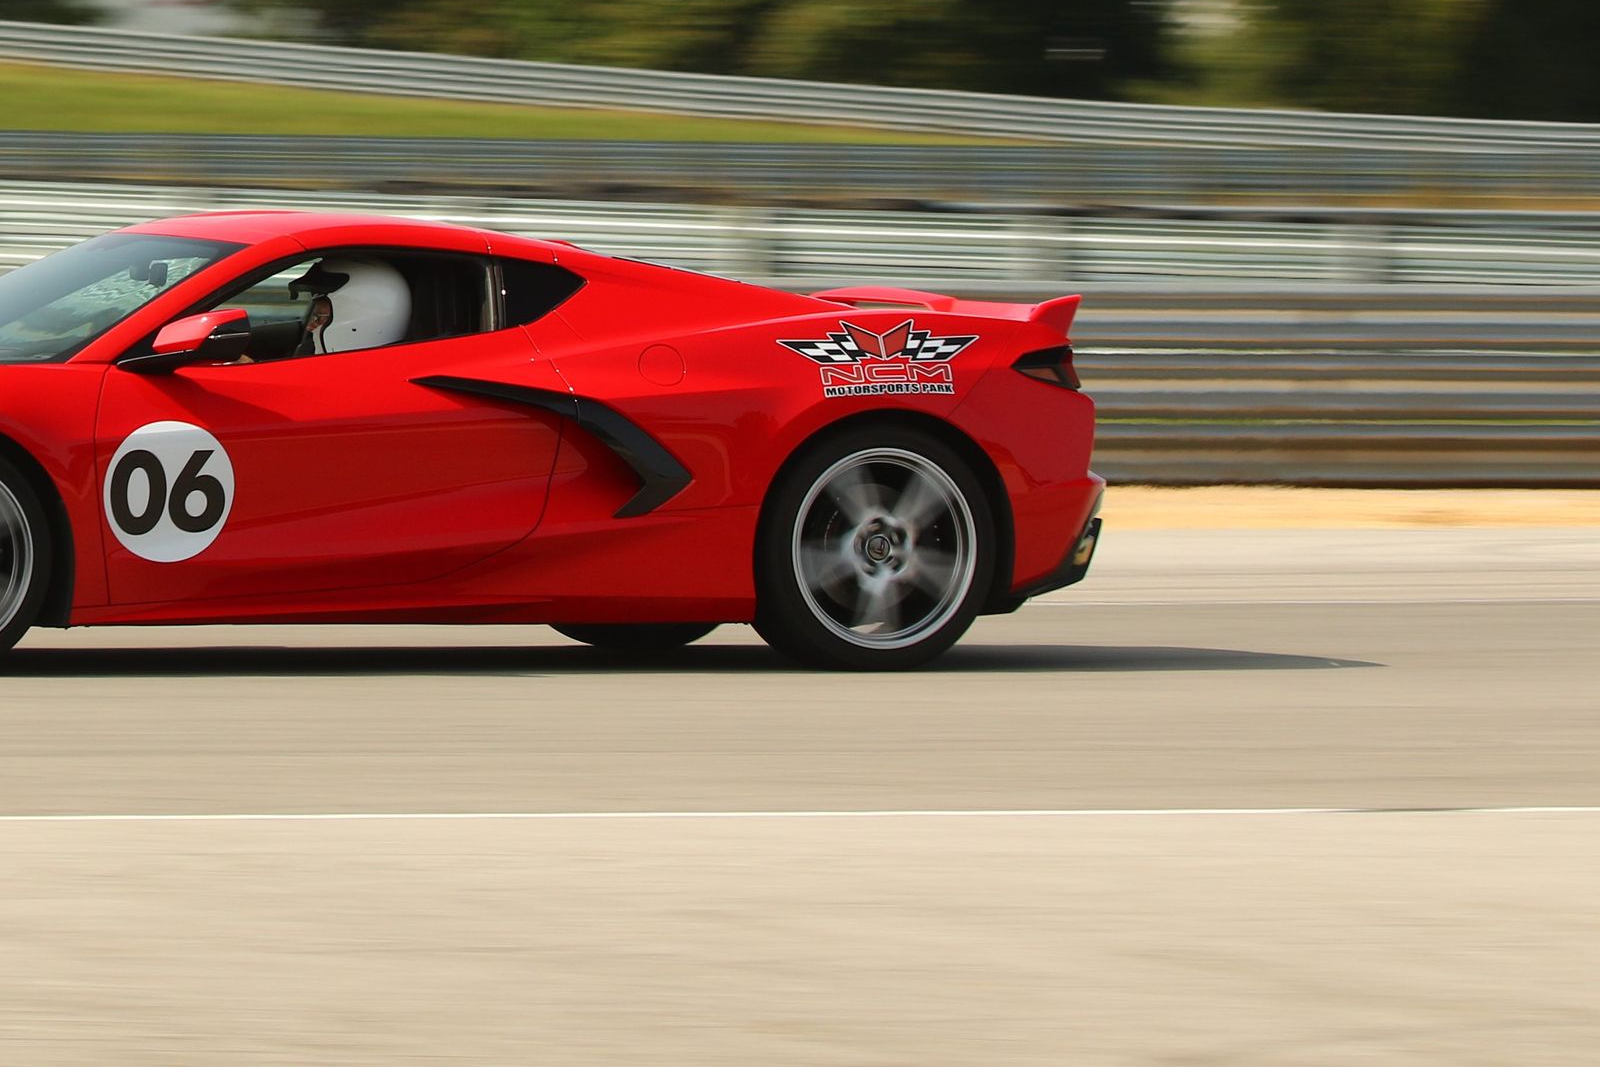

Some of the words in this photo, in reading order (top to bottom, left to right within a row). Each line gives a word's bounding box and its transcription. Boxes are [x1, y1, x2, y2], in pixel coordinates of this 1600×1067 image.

[820, 364, 953, 384] NCM
[825, 384, 919, 397] MOTORSPORTS
[922, 383, 954, 394] PARK
[110, 449, 226, 536] 06
